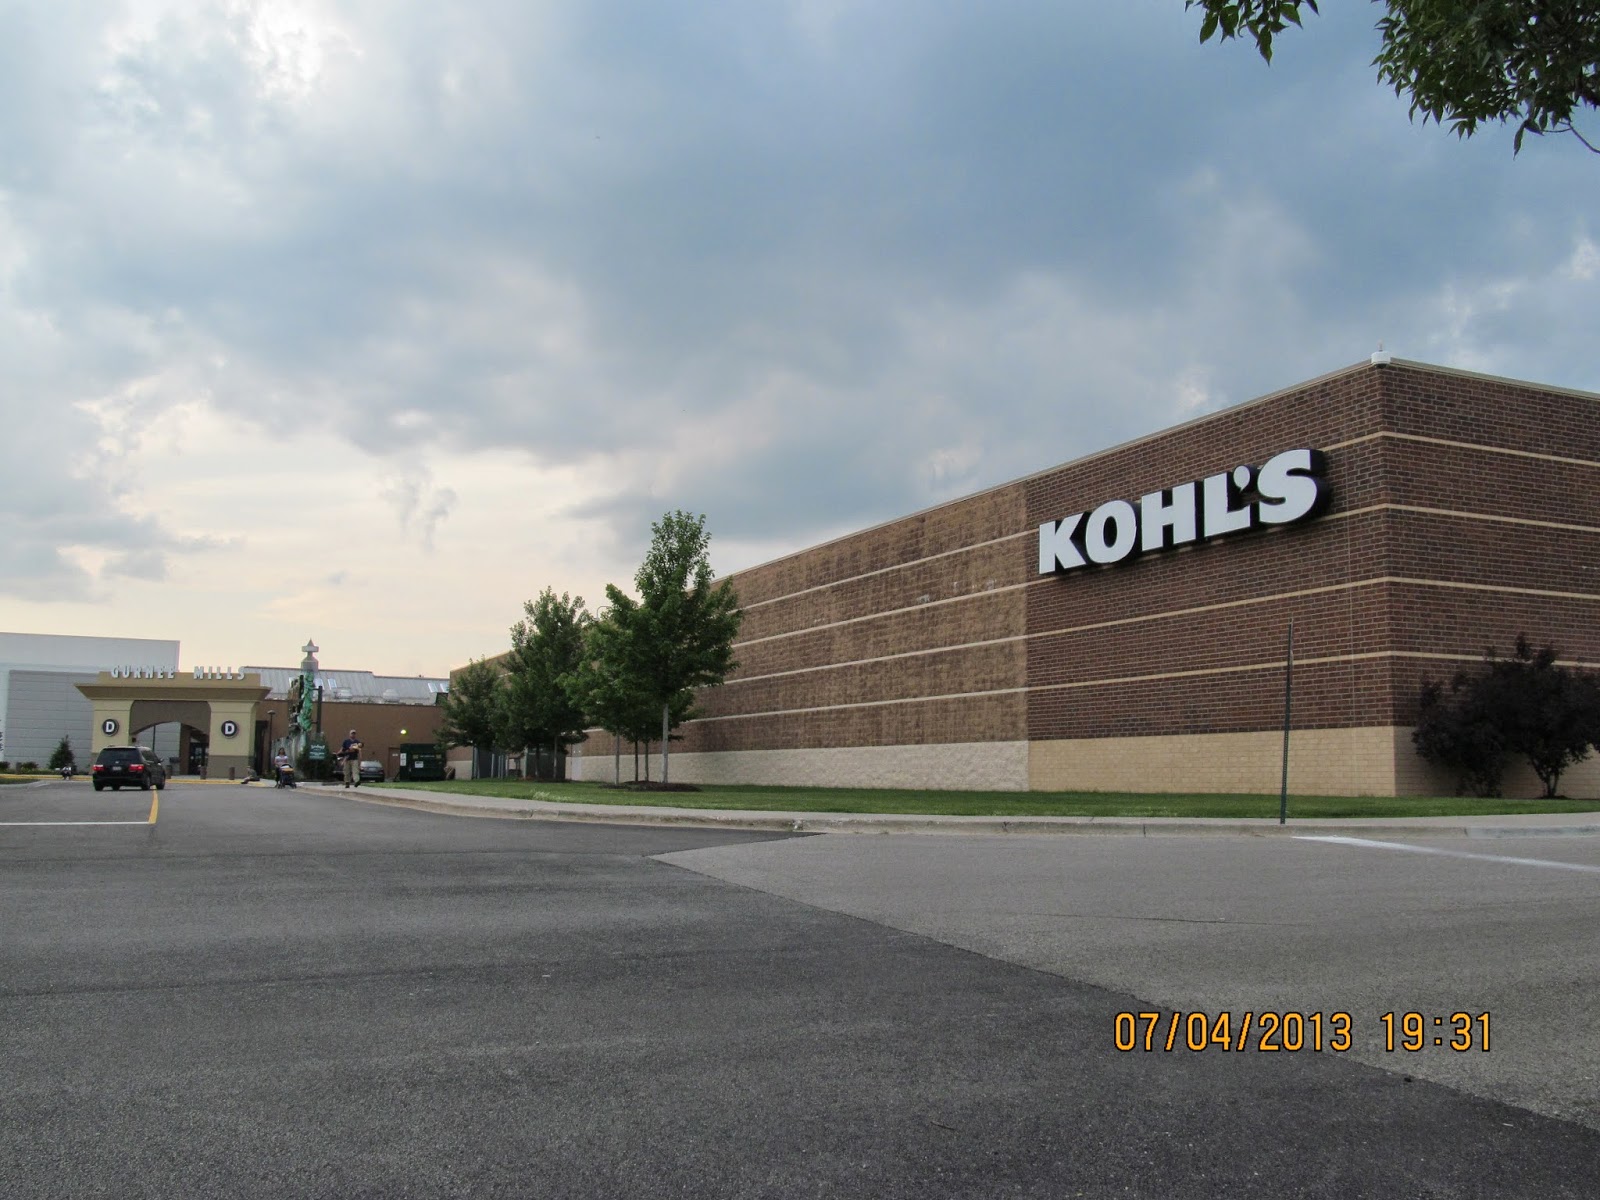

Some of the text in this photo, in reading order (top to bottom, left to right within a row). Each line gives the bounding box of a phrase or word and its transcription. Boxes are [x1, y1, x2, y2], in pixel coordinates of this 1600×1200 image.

[1038, 448, 1320, 575] KOHL'S
[110, 665, 246, 681] GURNEE MILLS
[105, 721, 116, 733] D
[224, 722, 235, 735] D
